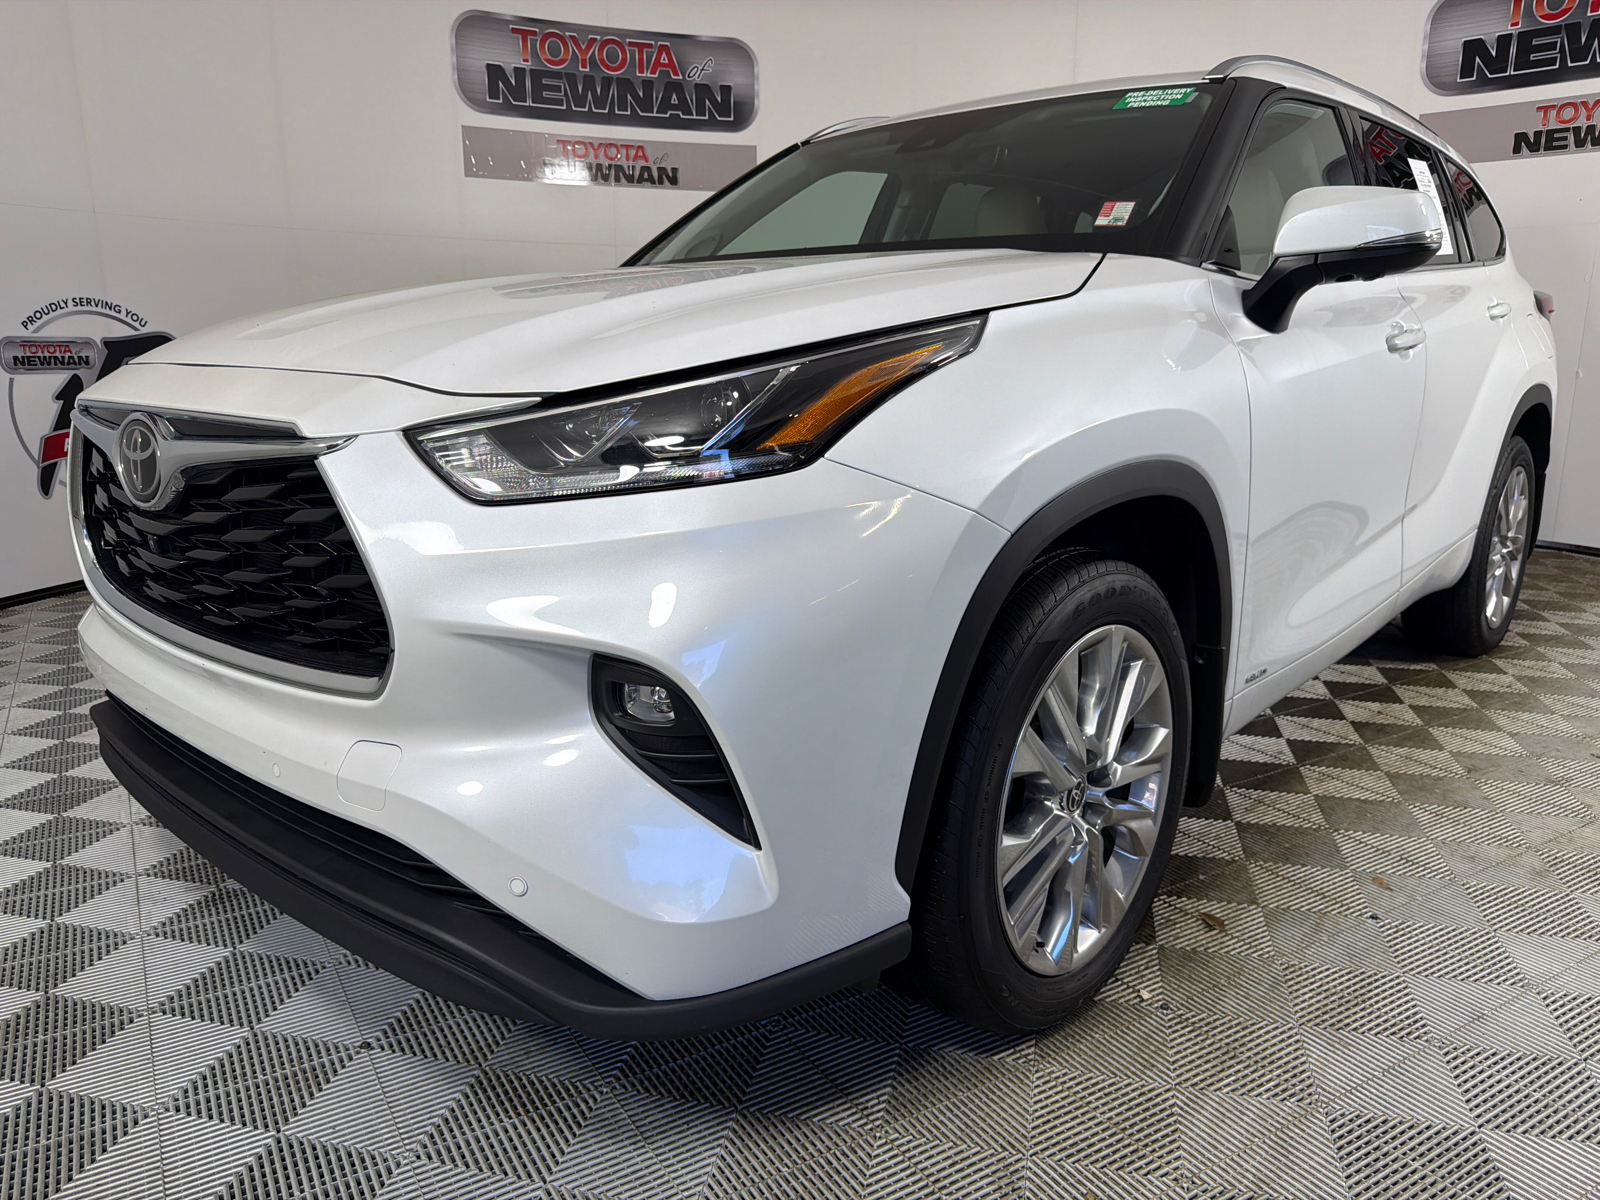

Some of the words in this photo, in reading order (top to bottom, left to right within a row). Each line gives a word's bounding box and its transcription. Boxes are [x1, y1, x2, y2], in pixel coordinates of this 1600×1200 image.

[510, 26, 681, 79] TOYOTA
[686, 58, 714, 81] of
[486, 63, 734, 121] NEWNAN
[1124, 93, 1184, 103] INSPECTION
[1125, 87, 1194, 98] PRE-DELIVERY
[1126, 99, 1171, 108] PENDING
[556, 139, 649, 164] TOYOTA
[653, 153, 669, 166] of
[542, 159, 679, 187] WNAN
[21, 298, 69, 331] PROUDLY
[72, 297, 122, 315] SERVING
[124, 308, 148, 328] YOU
[19, 344, 73, 355] TOYOTA
[12, 355, 90, 367] NEWNAN
